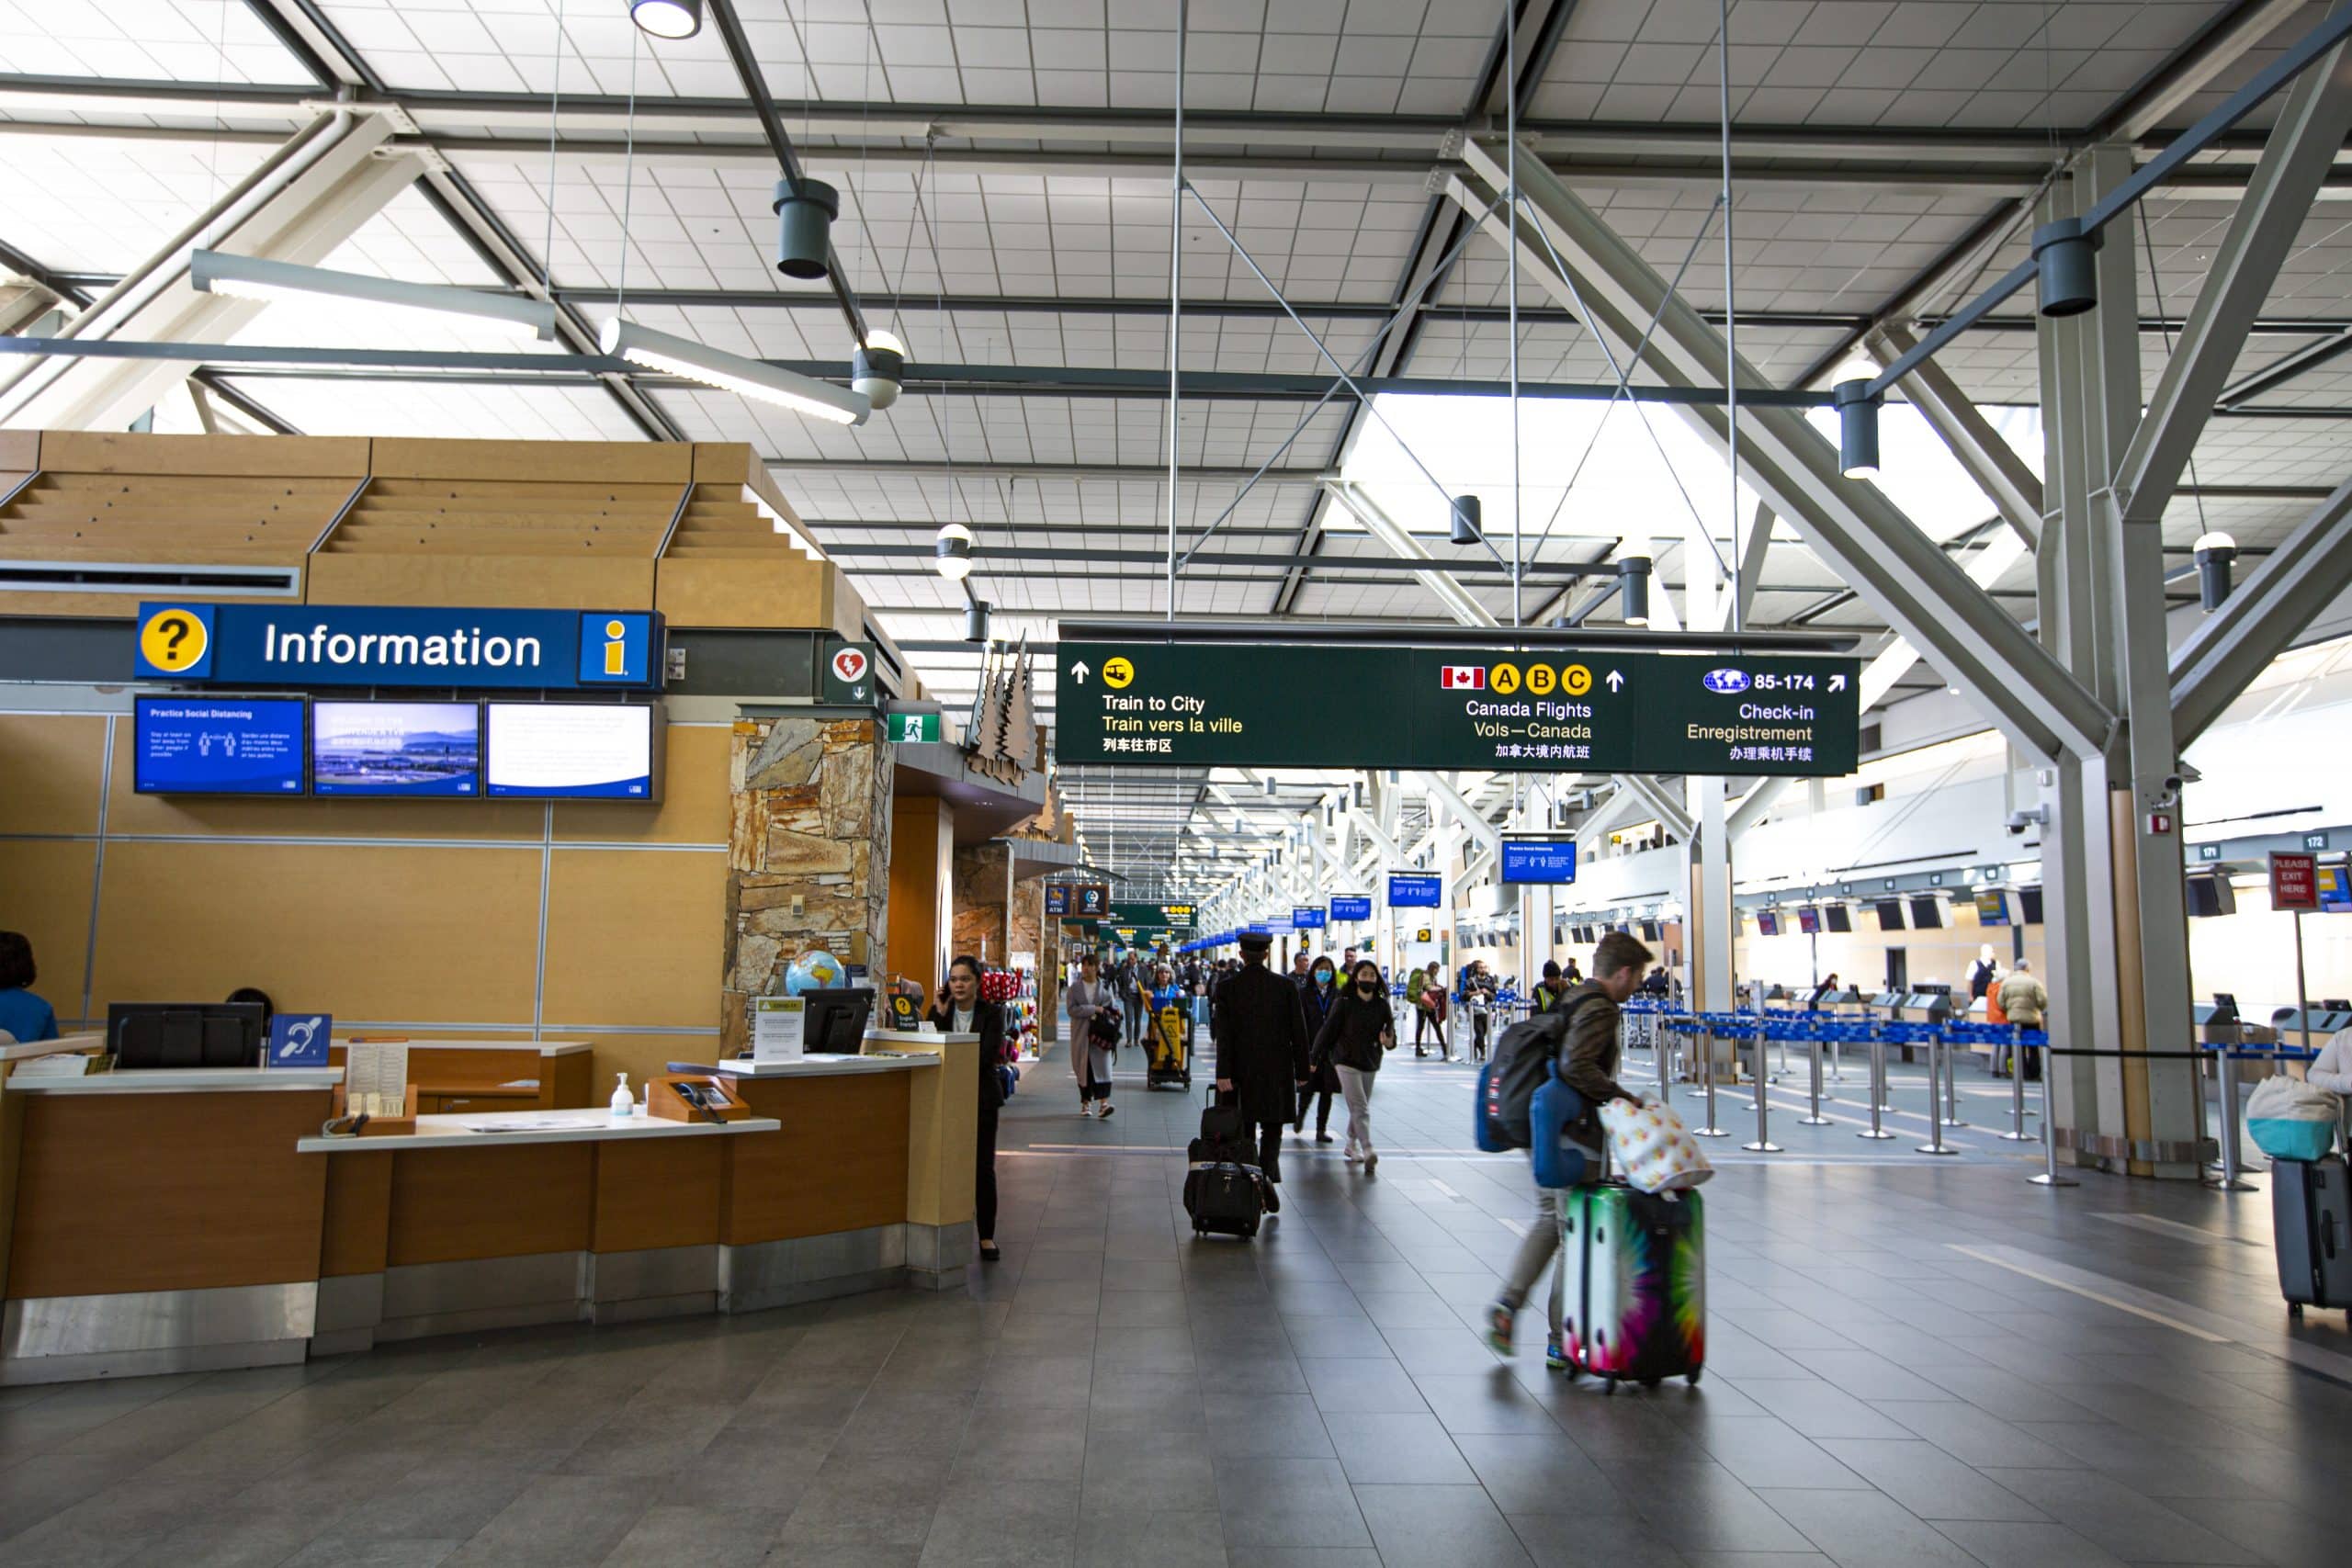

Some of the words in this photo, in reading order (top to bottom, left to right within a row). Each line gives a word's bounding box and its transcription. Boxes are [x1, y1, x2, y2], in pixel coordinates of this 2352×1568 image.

[265, 624, 541, 668] Information
[1496, 668, 1514, 687] A
[1533, 670, 1550, 688] B
[1568, 670, 1585, 689] C
[1754, 673, 1815, 690] 85-174
[1102, 694, 1144, 711] Train
[1148, 696, 1167, 711] to
[1170, 695, 1205, 715] City
[1465, 700, 1530, 716] Canada
[1536, 701, 1591, 720] Flights
[1739, 704, 1815, 720] Check-in
[150, 708, 184, 718] Practice
[186, 709, 209, 718] Social
[210, 709, 253, 720] Distancing
[1102, 716, 1143, 732] Train
[1148, 720, 1184, 732] vers
[1190, 717, 1204, 732] la
[1209, 717, 1243, 733] ville
[1687, 724, 1813, 743] Enregistrement
[1103, 738, 1172, 753] 列车往市区
[1495, 742, 1590, 759] 加拿大境内航班
[1729, 745, 1813, 761] 办理乘机手续
[2307, 836, 2324, 848] 172
[2203, 846, 2217, 858] 171
[2273, 859, 2311, 869] PLEASE
[2281, 872, 2303, 882] EXIT
[2279, 885, 2308, 895] HERE
